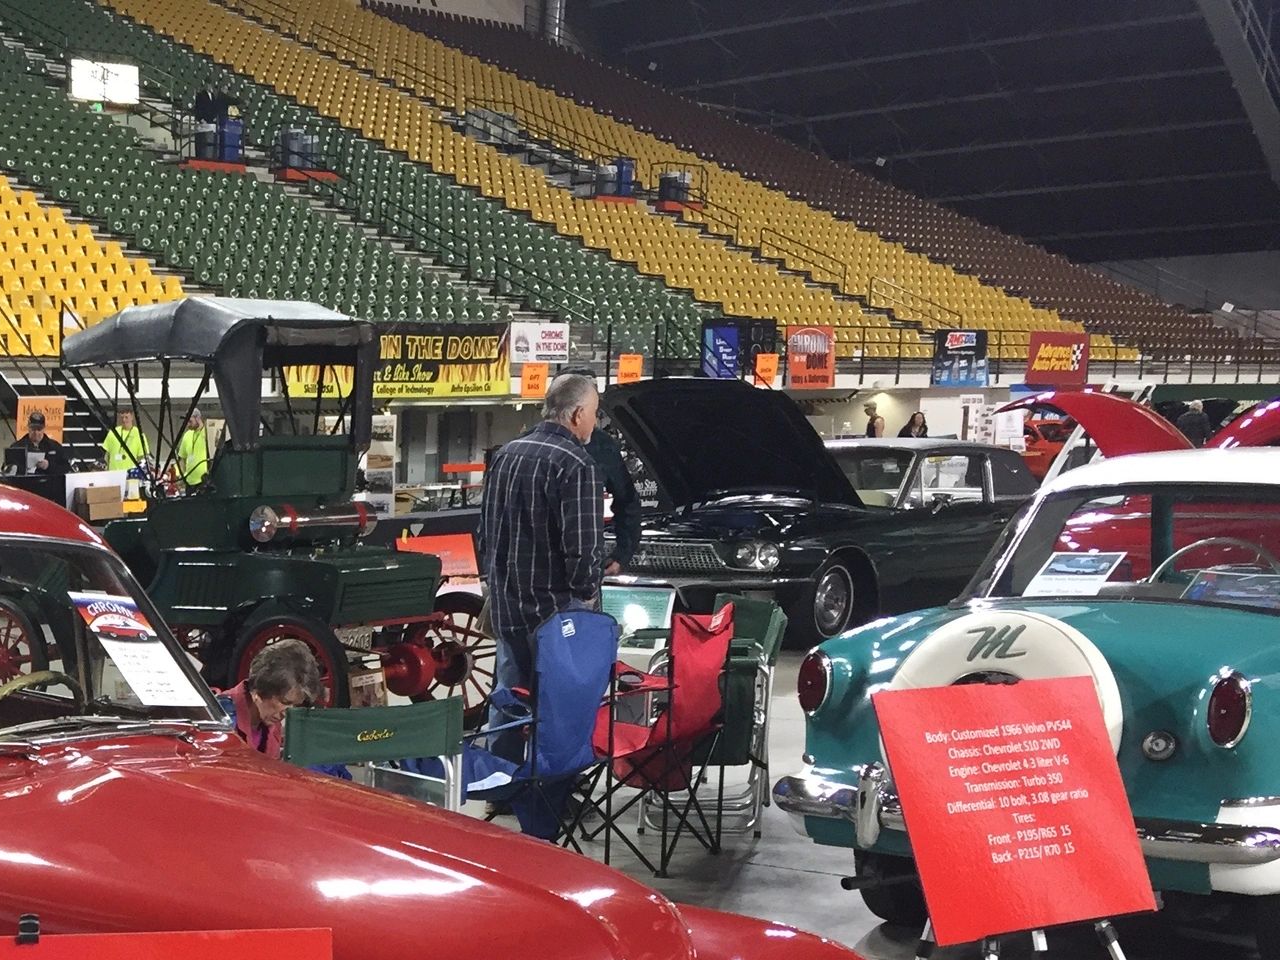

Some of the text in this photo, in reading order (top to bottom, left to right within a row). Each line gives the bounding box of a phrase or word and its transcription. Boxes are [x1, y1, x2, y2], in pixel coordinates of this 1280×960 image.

[540, 330, 564, 340] CHROME
[379, 335, 500, 360] IN THE DOME
[541, 342, 552, 352] THE
[411, 363, 434, 381] Show
[376, 384, 397, 396] College
[925, 719, 1073, 745] Body: Customized 1966 Volvo PV544
[947, 747, 983, 760] Chassis:
[982, 741, 1023, 757] Chevrolet
[1039, 738, 1061, 750] 2WD
[948, 764, 981, 779] Engine:
[981, 759, 1023, 775] Chevrolet
[1037, 755, 1054, 768] liter
[1054, 754, 1070, 766] V-6
[964, 772, 1063, 794] Transmission: Turbo 350
[946, 800, 997, 815] Differential:
[999, 796, 1011, 808] 10
[1010, 793, 1031, 807] bolt,
[1050, 792, 1069, 805] gear
[1069, 788, 1089, 800] ratio
[1012, 811, 1036, 825] Tires:
[987, 833, 1011, 846] Front
[1016, 826, 1057, 842] P195/R65
[1060, 825, 1072, 836] 15
[991, 851, 1013, 864] Back
[1044, 843, 1061, 856] R70
[1064, 842, 1076, 854] 15
